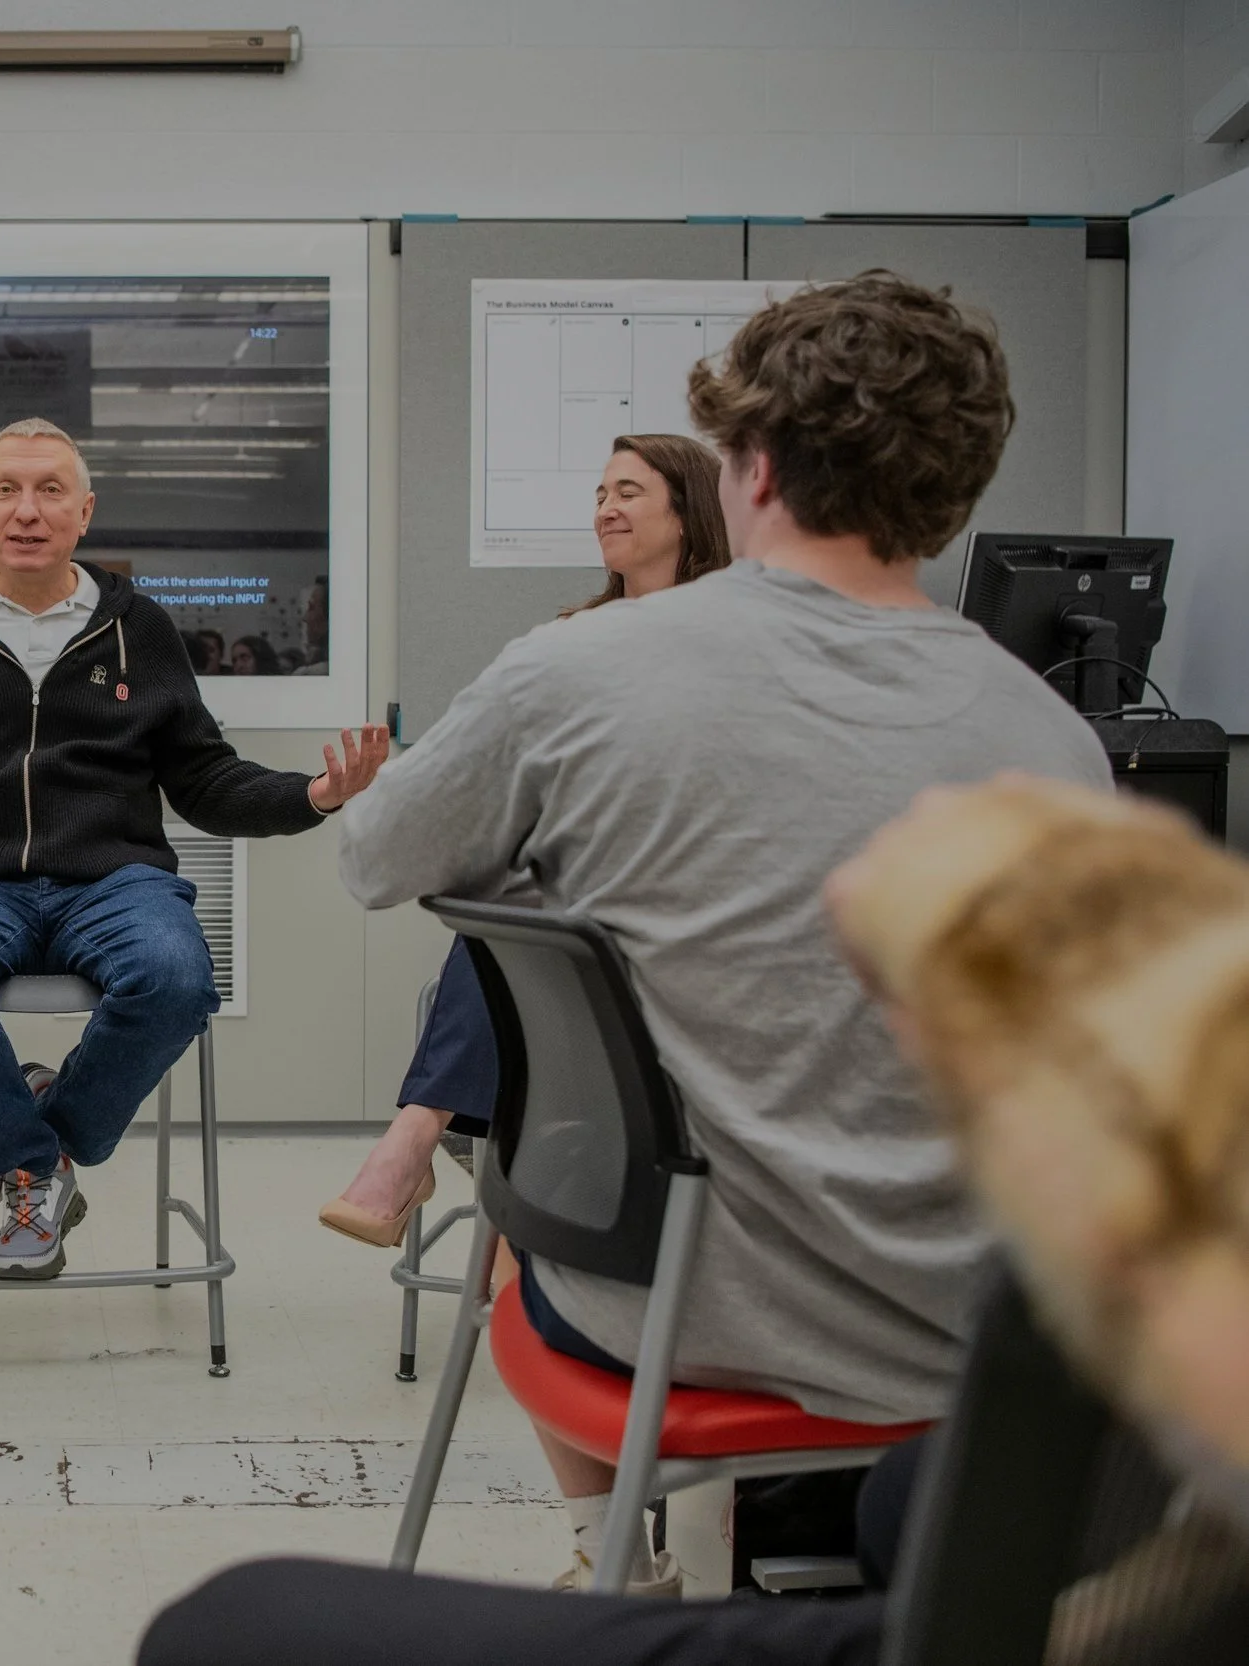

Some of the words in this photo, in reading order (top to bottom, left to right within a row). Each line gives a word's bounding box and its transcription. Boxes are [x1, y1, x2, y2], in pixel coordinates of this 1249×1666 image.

[487, 301, 503, 309] The
[506, 301, 547, 309] Business
[550, 301, 578, 309] Model
[581, 301, 614, 309] Canvas
[250, 327, 278, 339] 14:22
[139, 576, 170, 587] Check
[170, 576, 188, 587] the
[189, 576, 229, 587] external
[230, 576, 256, 589] input
[257, 578, 269, 587] or
[160, 593, 187, 605] input
[188, 593, 216, 606] using
[217, 593, 234, 604] the
[235, 593, 265, 604] INPUT
